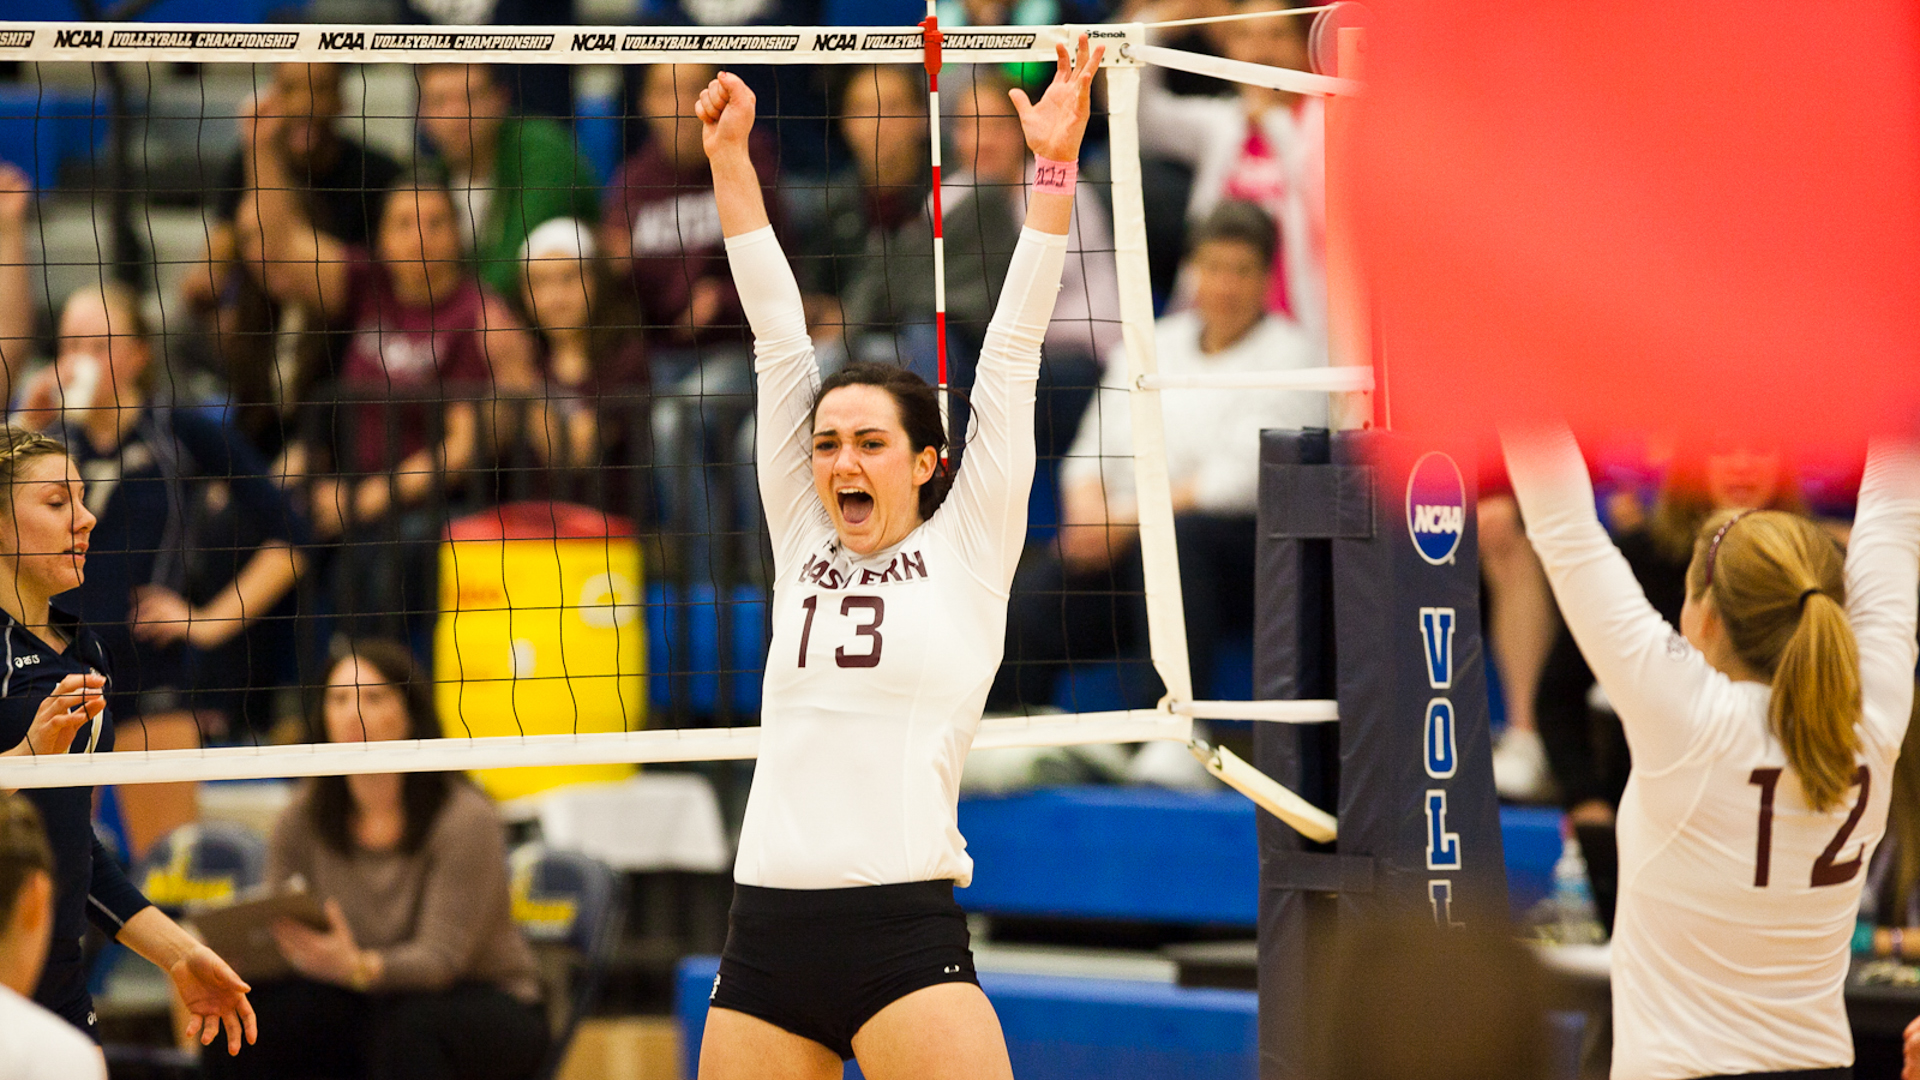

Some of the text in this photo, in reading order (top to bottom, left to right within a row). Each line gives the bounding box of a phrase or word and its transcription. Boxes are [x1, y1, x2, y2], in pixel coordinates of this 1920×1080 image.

[53, 30, 297, 48] NCAA VOLLEYBALL CHAMPIONSHIP
[318, 32, 552, 50] NCAA VOLLEYBALL CHAMPIONSHIP
[571, 34, 798, 51] NCAA VOLLEYBALL CHAMPIONSHIP
[812, 34, 1034, 51] NCAA VOLLEYBA CHAMPIONSHIP
[1092, 30, 1126, 38] Senoh
[1413, 504, 1462, 534] NCAA
[798, 550, 928, 590] ASERN
[797, 594, 885, 669] 13
[1748, 764, 1871, 888] 12
